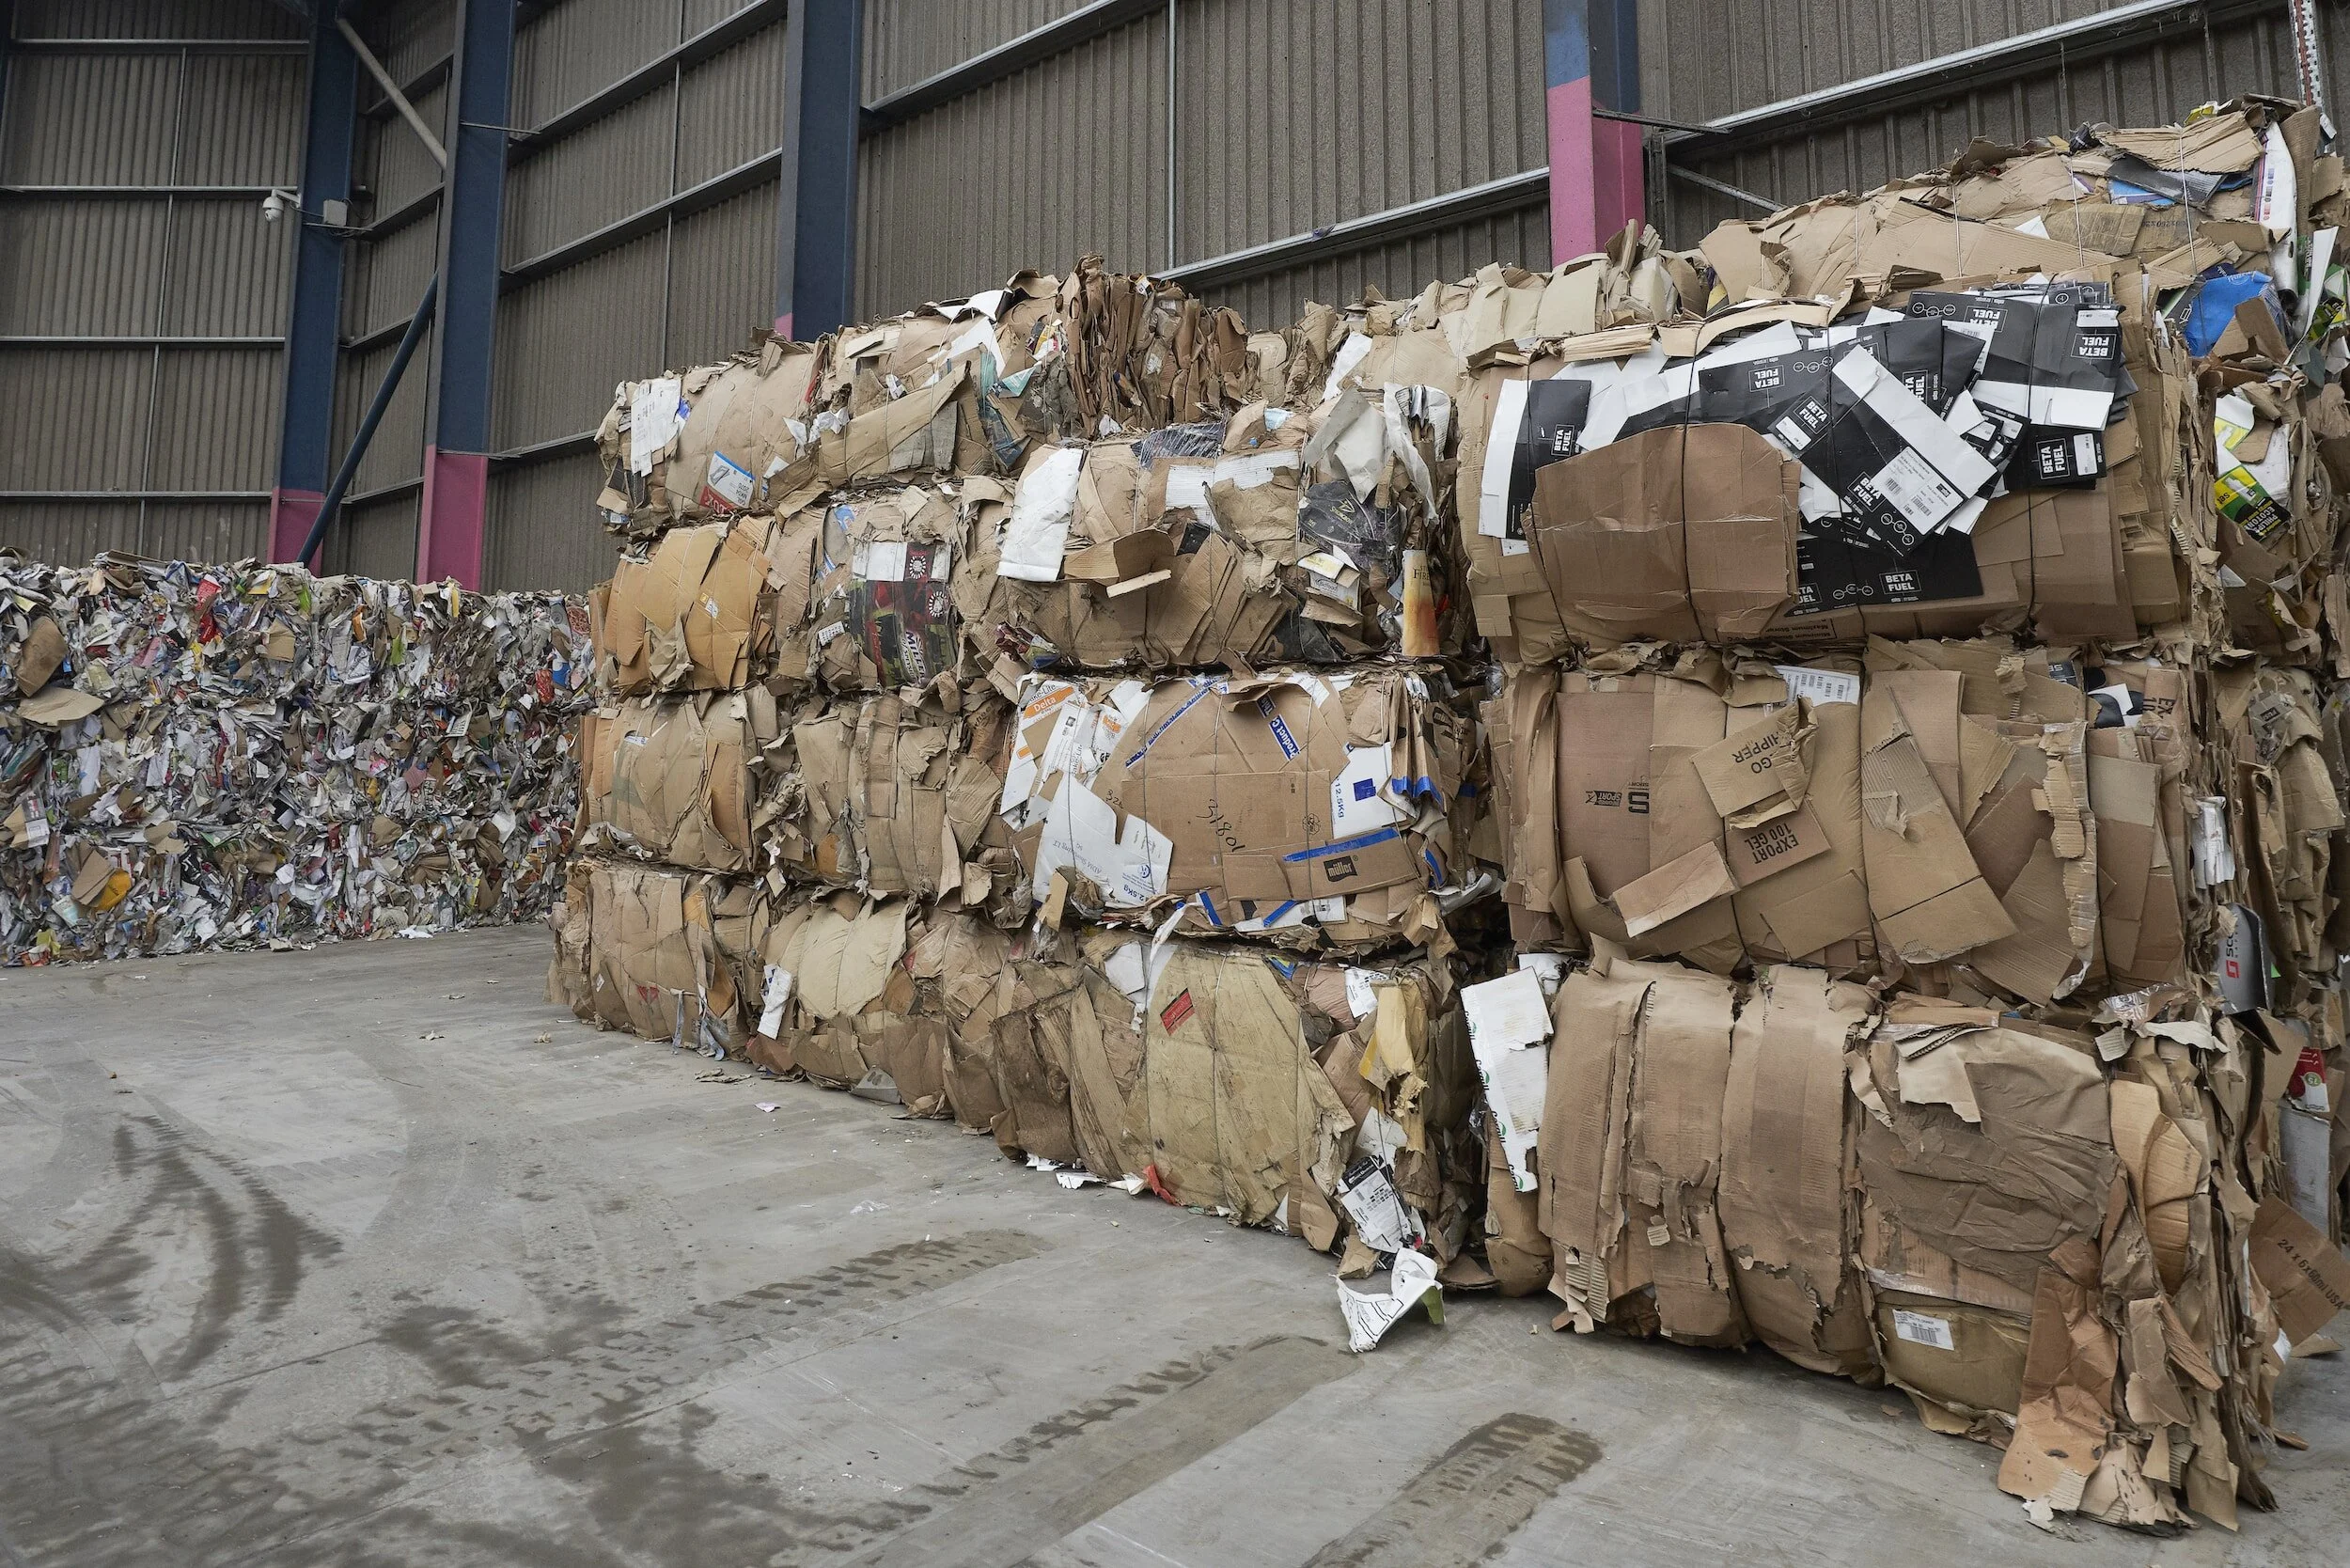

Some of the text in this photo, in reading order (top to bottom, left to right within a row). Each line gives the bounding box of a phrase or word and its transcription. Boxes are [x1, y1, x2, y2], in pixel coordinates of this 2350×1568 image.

[1972, 308, 2000, 321] FUEL
[2078, 346, 2108, 357] BETA
[2081, 337, 2110, 347] FUEL
[1754, 368, 1778, 379] FUEL
[1754, 377, 1779, 389] BETA
[1798, 407, 1819, 430] FUEL
[1805, 399, 1828, 423] BETA
[1554, 429, 1564, 452] BETA
[1562, 430, 1572, 453] FUEL
[2041, 446, 2053, 474] BETA
[2053, 444, 2066, 471] FUEL
[1853, 486, 1873, 508] FUEL
[1859, 477, 1882, 500] BETA
[1885, 573, 1913, 584] BETA
[1888, 581, 1915, 592] FUEL
[1033, 696, 1058, 713] Delta
[1277, 724, 1299, 760] Product
[1732, 730, 1779, 763] HIPPER
[1750, 756, 1773, 775] GO
[1744, 823, 1793, 851] 100 GEL
[1754, 835, 1799, 865] EXPORT
[1327, 862, 1353, 876] müller
[2278, 1238, 2293, 1254] 24
[2325, 1290, 2346, 1309] USA
